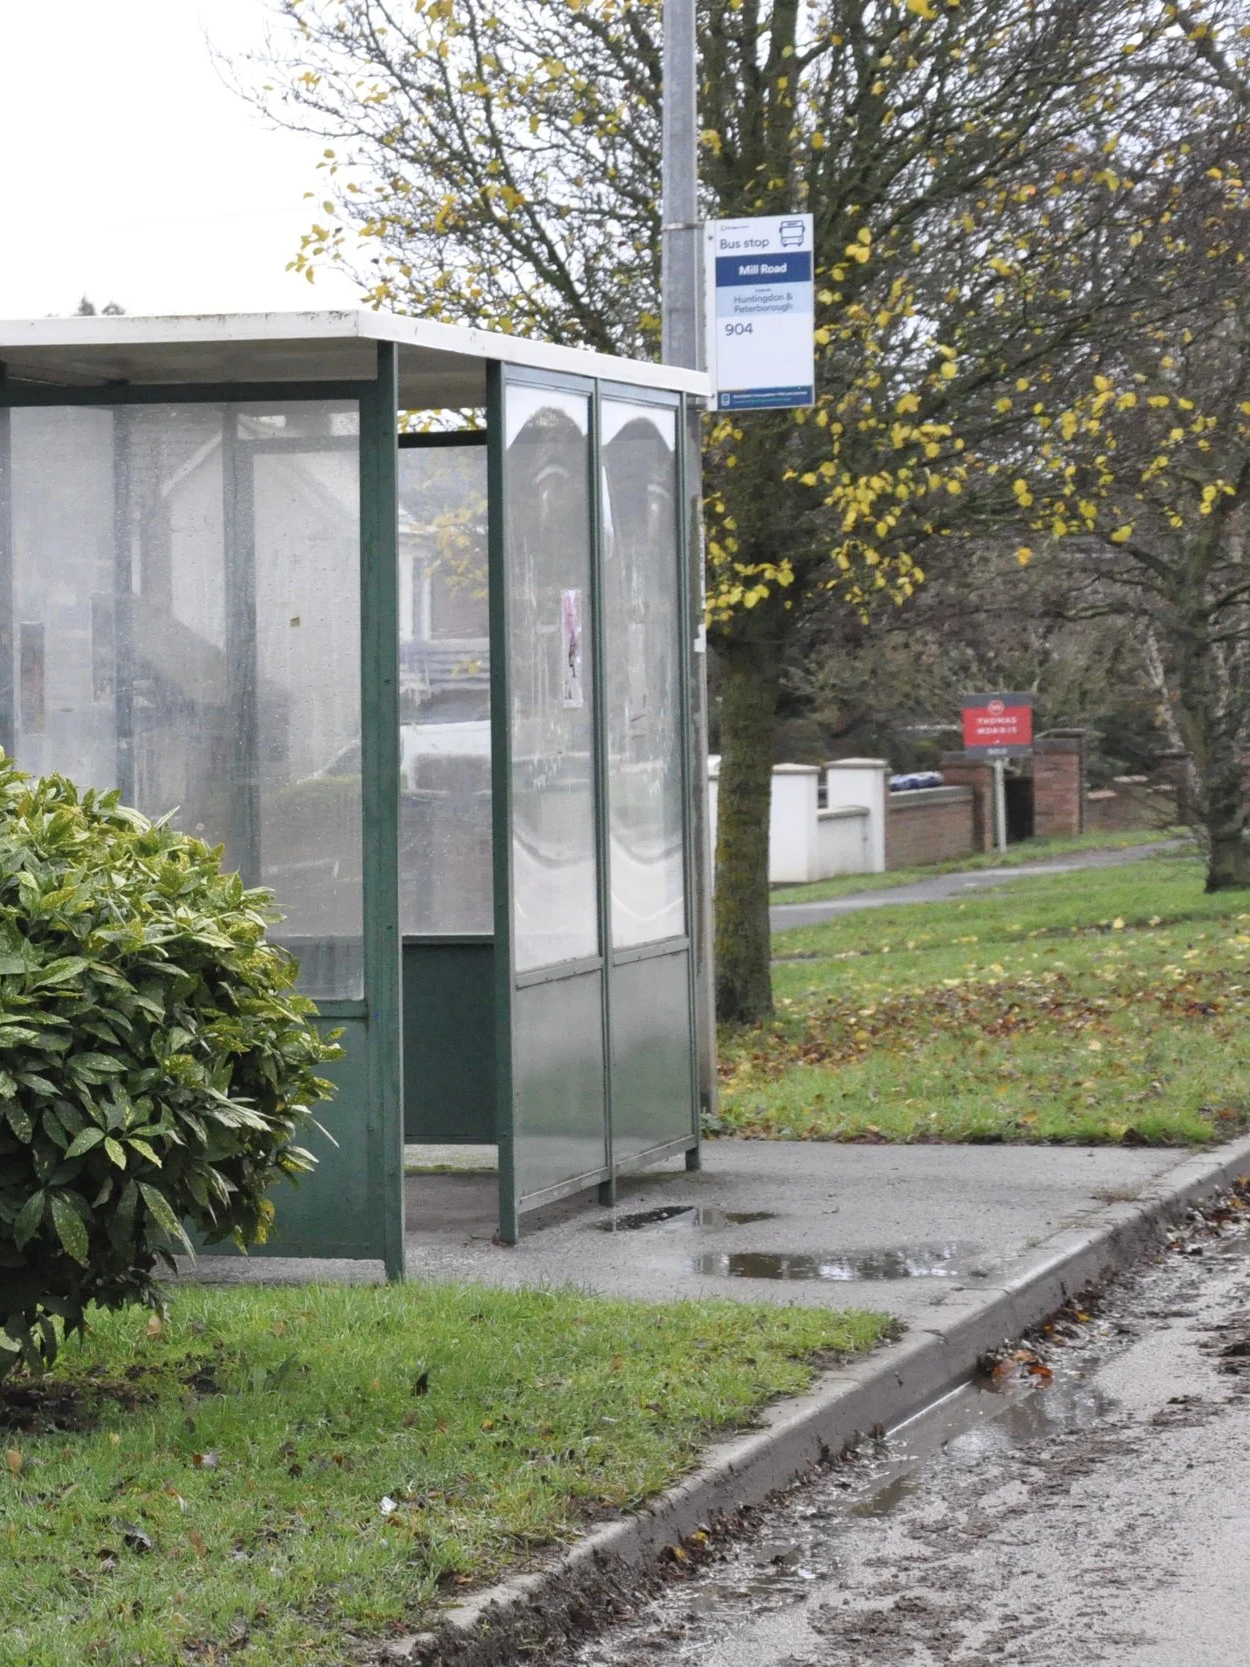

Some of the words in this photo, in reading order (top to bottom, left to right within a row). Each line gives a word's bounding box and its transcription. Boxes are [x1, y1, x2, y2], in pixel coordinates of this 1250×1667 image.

[720, 239, 742, 250] Bus
[744, 237, 770, 249] stop
[738, 264, 759, 276] Mill
[760, 262, 788, 275] Road
[734, 293, 785, 304] Huntingdon
[786, 292, 794, 301] &
[734, 302, 794, 313] Peterborough
[725, 322, 754, 336] 904
